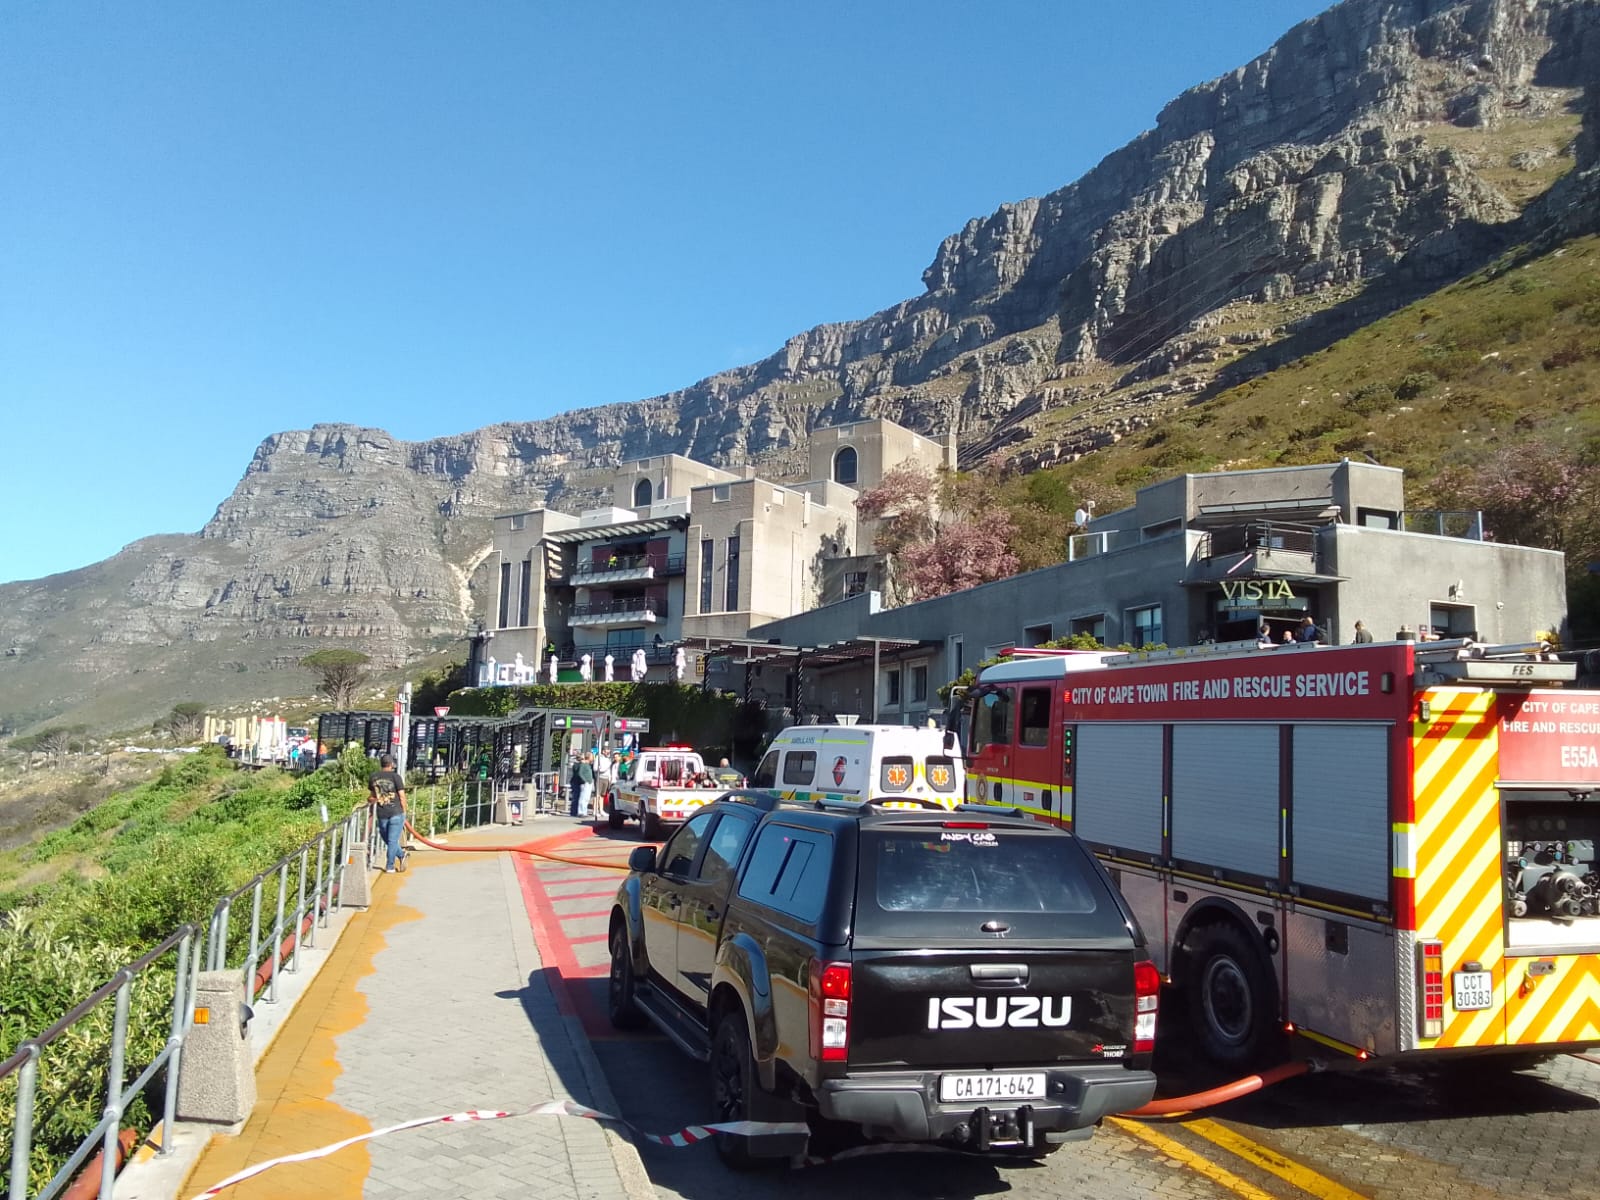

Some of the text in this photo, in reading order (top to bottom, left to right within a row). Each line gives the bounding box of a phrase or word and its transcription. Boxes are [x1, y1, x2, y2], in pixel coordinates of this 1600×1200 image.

[1220, 579, 1296, 600] VISTA
[1512, 665, 1534, 676] FES
[1072, 671, 1369, 705] CITY OF CAPE TOWN FIRE AND RESCUE SERVICE
[1522, 701, 1599, 714] CITY OF CAPE
[1503, 721, 1529, 733] FIRE
[1532, 721, 1556, 733] AND
[1561, 746, 1598, 768] E55A
[941, 832, 996, 843] ANDY CAB
[1463, 975, 1482, 990] CCT
[1457, 991, 1490, 1006] 30383
[927, 996, 1072, 1029] ISUZU
